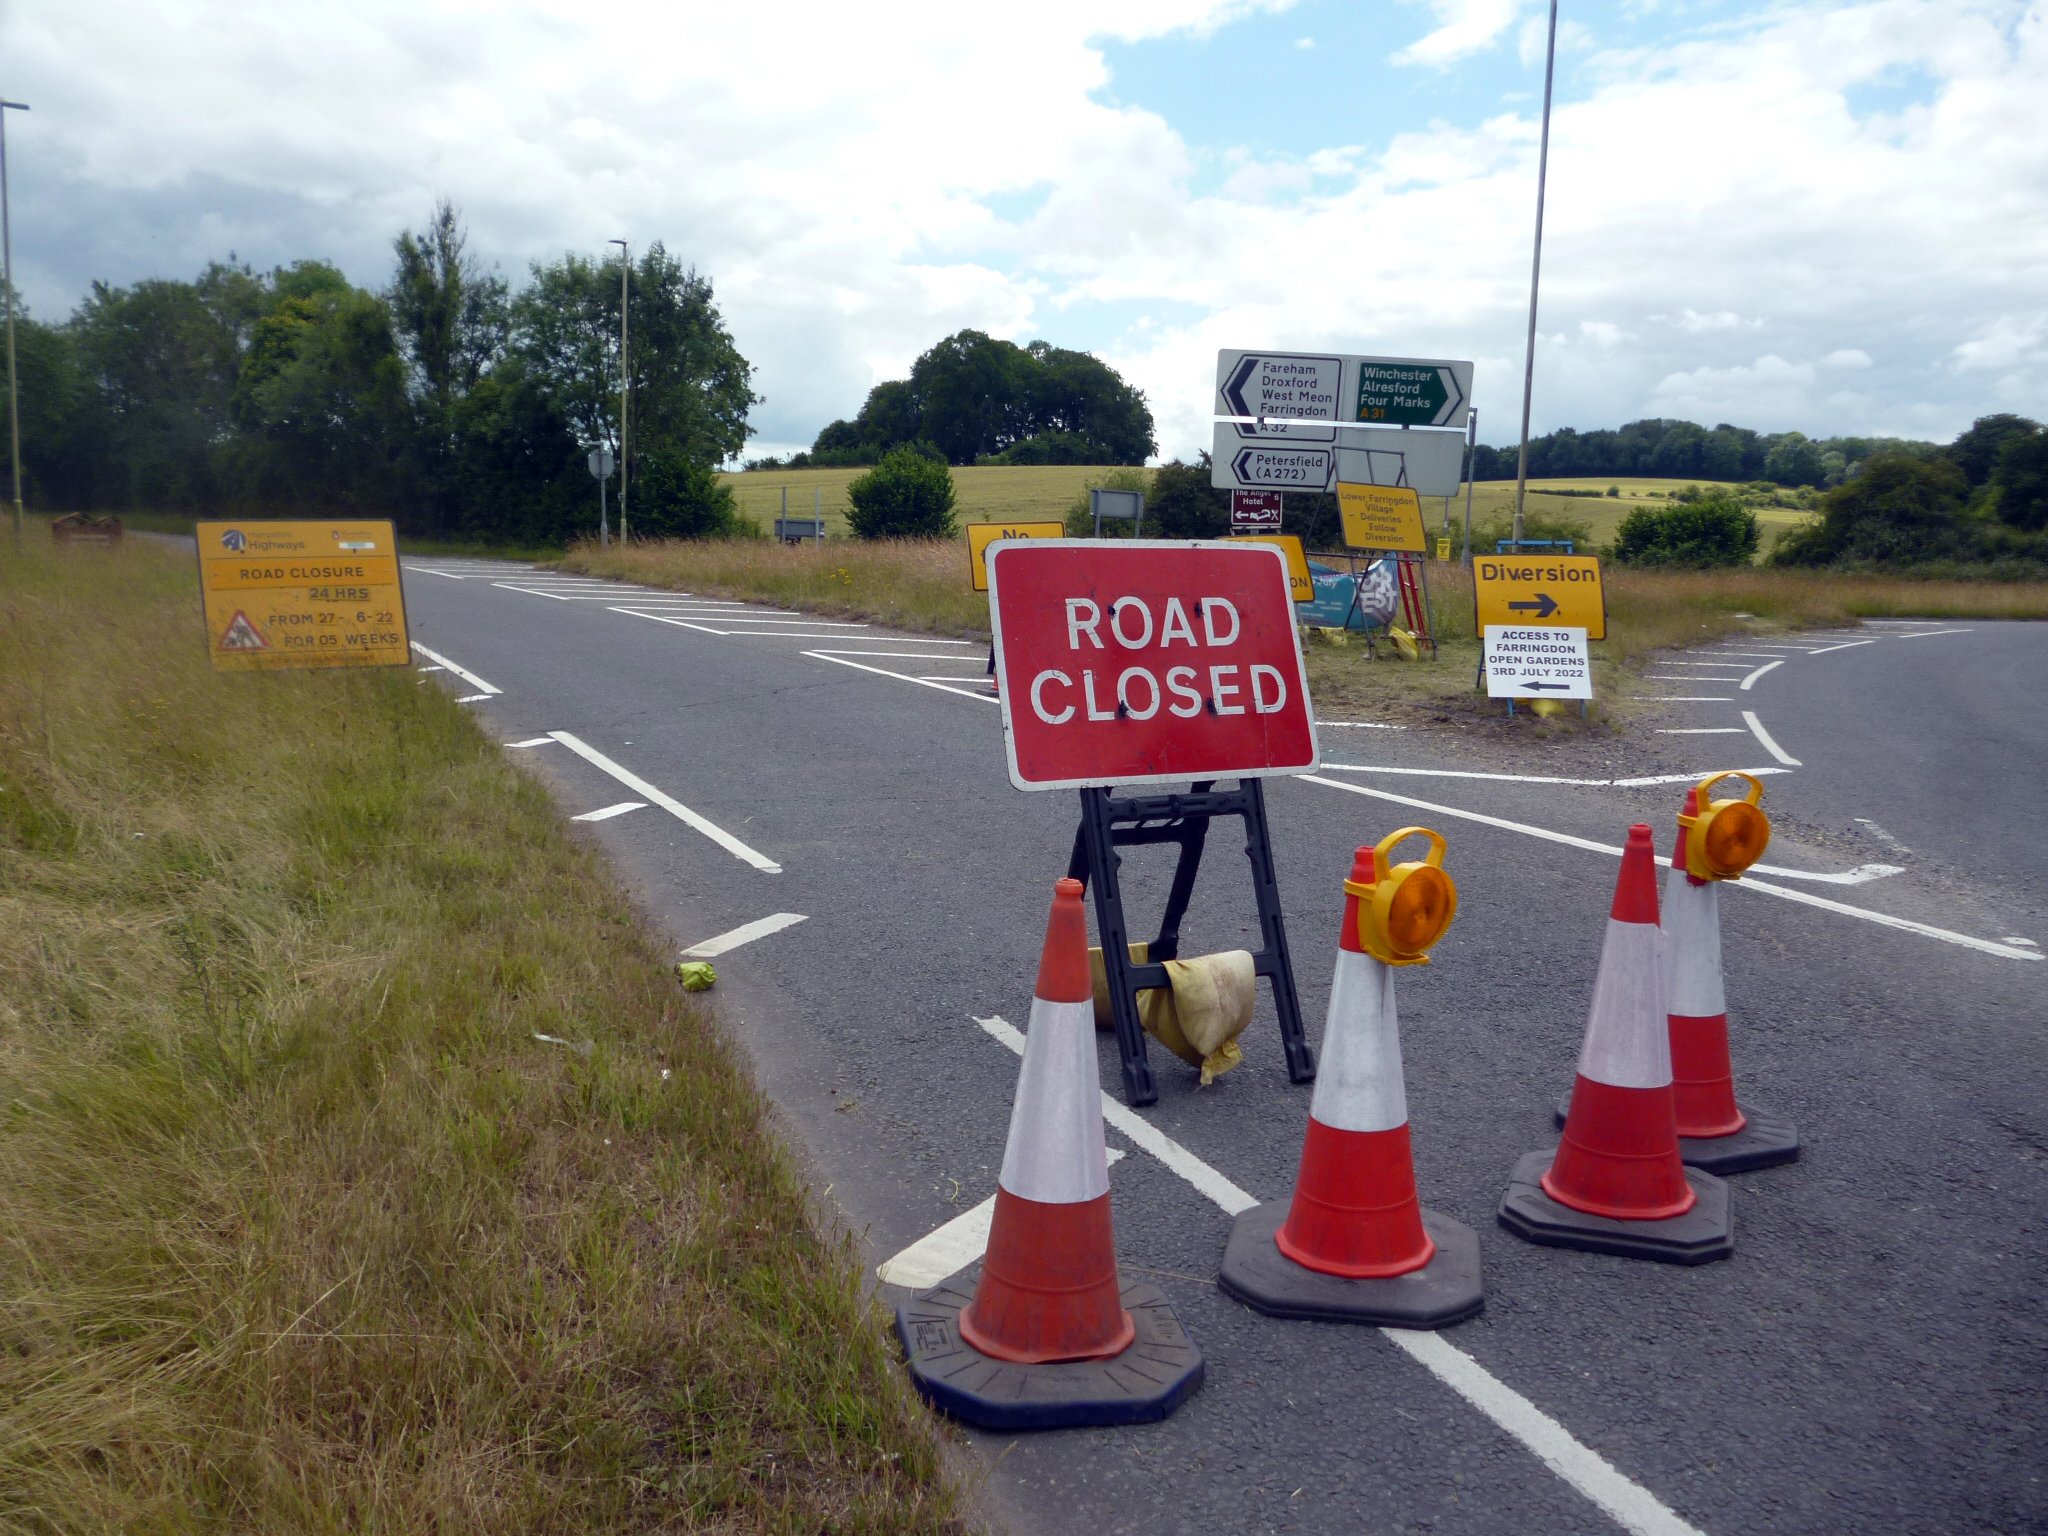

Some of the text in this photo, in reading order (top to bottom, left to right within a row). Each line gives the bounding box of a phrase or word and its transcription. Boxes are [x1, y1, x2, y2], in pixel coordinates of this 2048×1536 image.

[1263, 362, 1316, 375] Fareham
[1364, 367, 1432, 382] Winchester
[1262, 376, 1317, 389] Droxford
[1363, 381, 1420, 394] Alresford
[1262, 389, 1332, 403] West Meon
[1360, 394, 1431, 409] Four Marks
[1260, 403, 1327, 417] Farringdon
[1256, 454, 1323, 468] Petersfield
[1341, 492, 1414, 505] Lower Farringdon
[1365, 502, 1394, 514] Village
[1361, 512, 1402, 523] Deliveries
[1369, 523, 1397, 532] Follow
[1365, 532, 1404, 543] Diversion
[249, 540, 305, 552] Highways
[240, 567, 364, 580] ROAD CLOSURE
[1481, 564, 1595, 582] Diversion
[310, 588, 369, 599] 24 HRS
[269, 613, 314, 626] FROM
[1065, 596, 1240, 650] ROAD
[285, 633, 399, 647] FOR 05 WEEKS
[1501, 631, 1569, 642] ACCESS TO
[1496, 643, 1576, 654] FARRINGDON
[1489, 655, 1585, 666] OPEN GARDENS
[1492, 667, 1584, 678] 3RD JULY 2022
[1030, 664, 1287, 725] CLOSED
